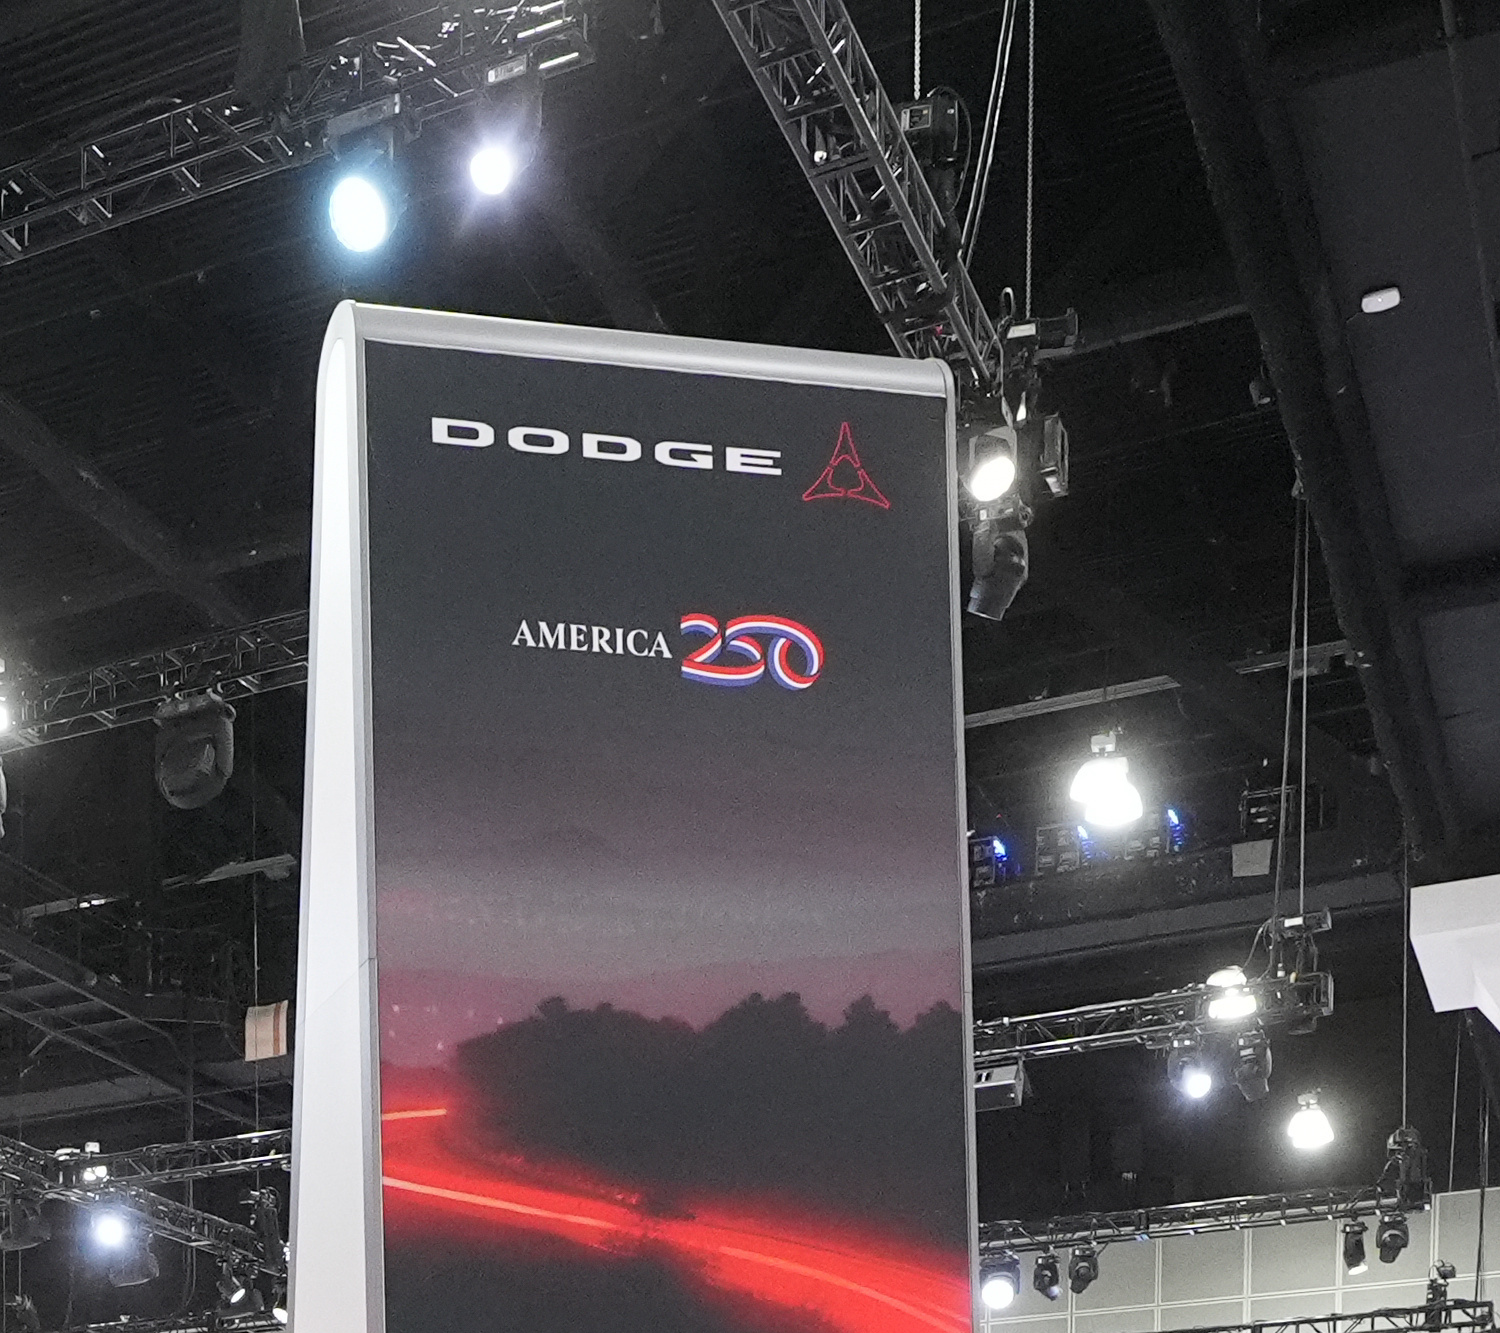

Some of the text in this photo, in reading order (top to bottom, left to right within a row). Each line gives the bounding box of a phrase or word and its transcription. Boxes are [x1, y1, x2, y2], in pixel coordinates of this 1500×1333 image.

[431, 416, 782, 476] DODGE
[511, 613, 825, 690] AMERICA 250
